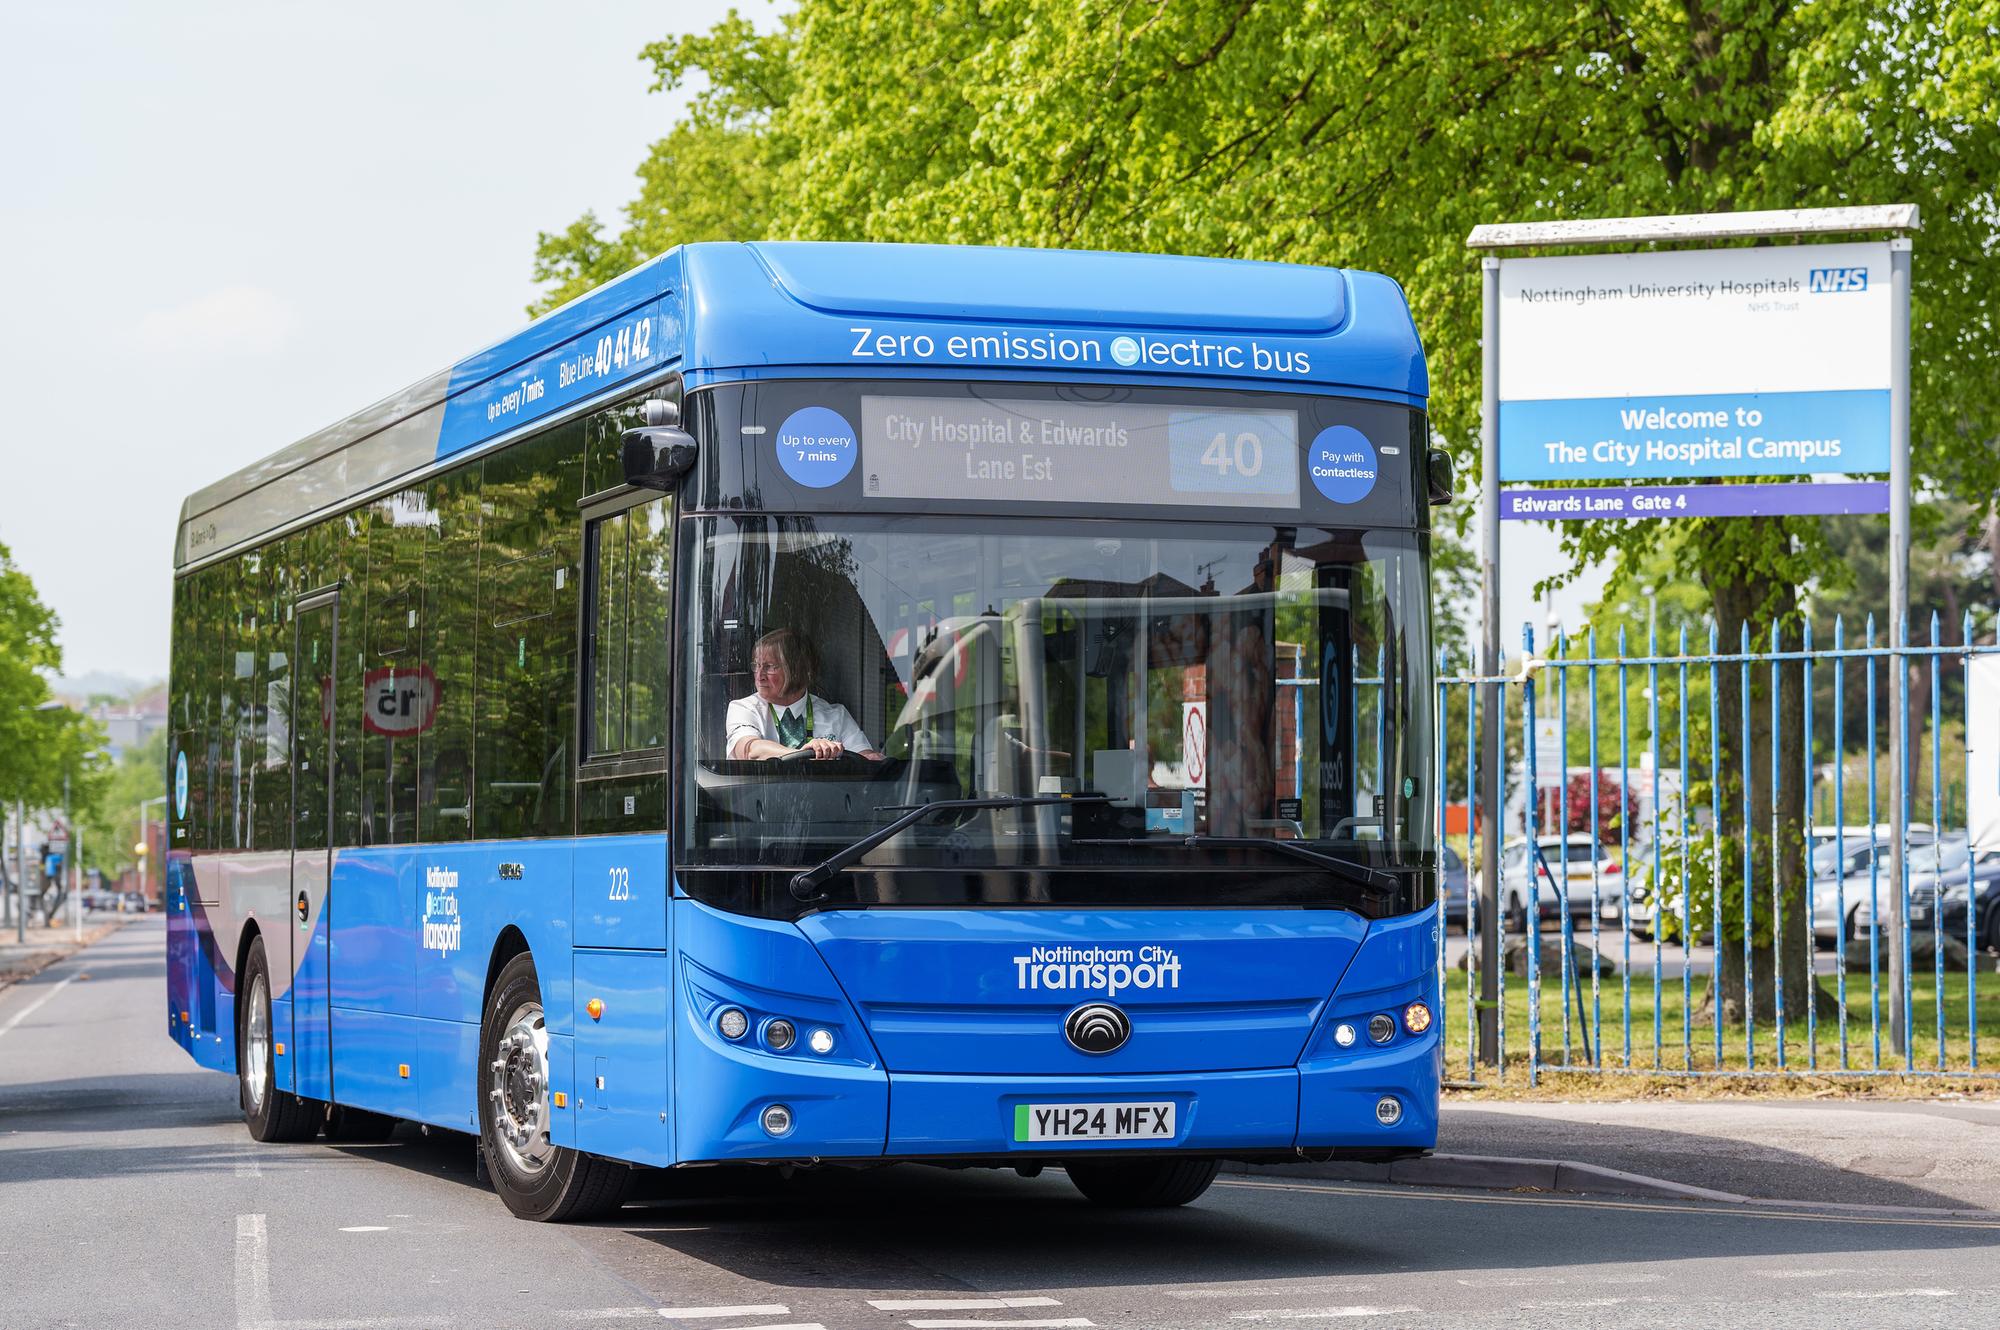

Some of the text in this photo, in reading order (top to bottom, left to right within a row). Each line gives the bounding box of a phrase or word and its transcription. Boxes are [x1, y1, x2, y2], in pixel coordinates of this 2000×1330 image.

[1521, 277, 1800, 306] Nottingham University Hospitals
[1810, 268, 1867, 293] NHS
[1748, 301, 1800, 312] NHS Trust
[559, 317, 650, 389] Blue Line 40 41 42
[850, 327, 1311, 374] Zero emission electric bus
[487, 403, 495, 423] Up
[501, 390, 521, 415] every
[521, 381, 527, 405] 7
[527, 376, 544, 403] mins
[886, 415, 1128, 449] City Hospital & Edwards
[1621, 407, 1762, 430] Welcome to
[782, 435, 851, 448] Up to every
[796, 451, 837, 461] 7 mins
[1201, 432, 1263, 477] 40
[1545, 436, 1841, 467] The City Hospital Campus
[966, 452, 1053, 481] Lane Est
[1322, 450, 1364, 465] Pay with
[1312, 466, 1375, 479] Contactless
[1513, 494, 1687, 513] Edwards Lane Gate 4
[426, 866, 459, 892] Nottingham
[608, 867, 629, 901] 223
[422, 914, 461, 959] Transport
[1032, 945, 1173, 968] Nottingham City
[1013, 955, 1182, 997] Transport
[1035, 1107, 1169, 1136] YH24 MFX
